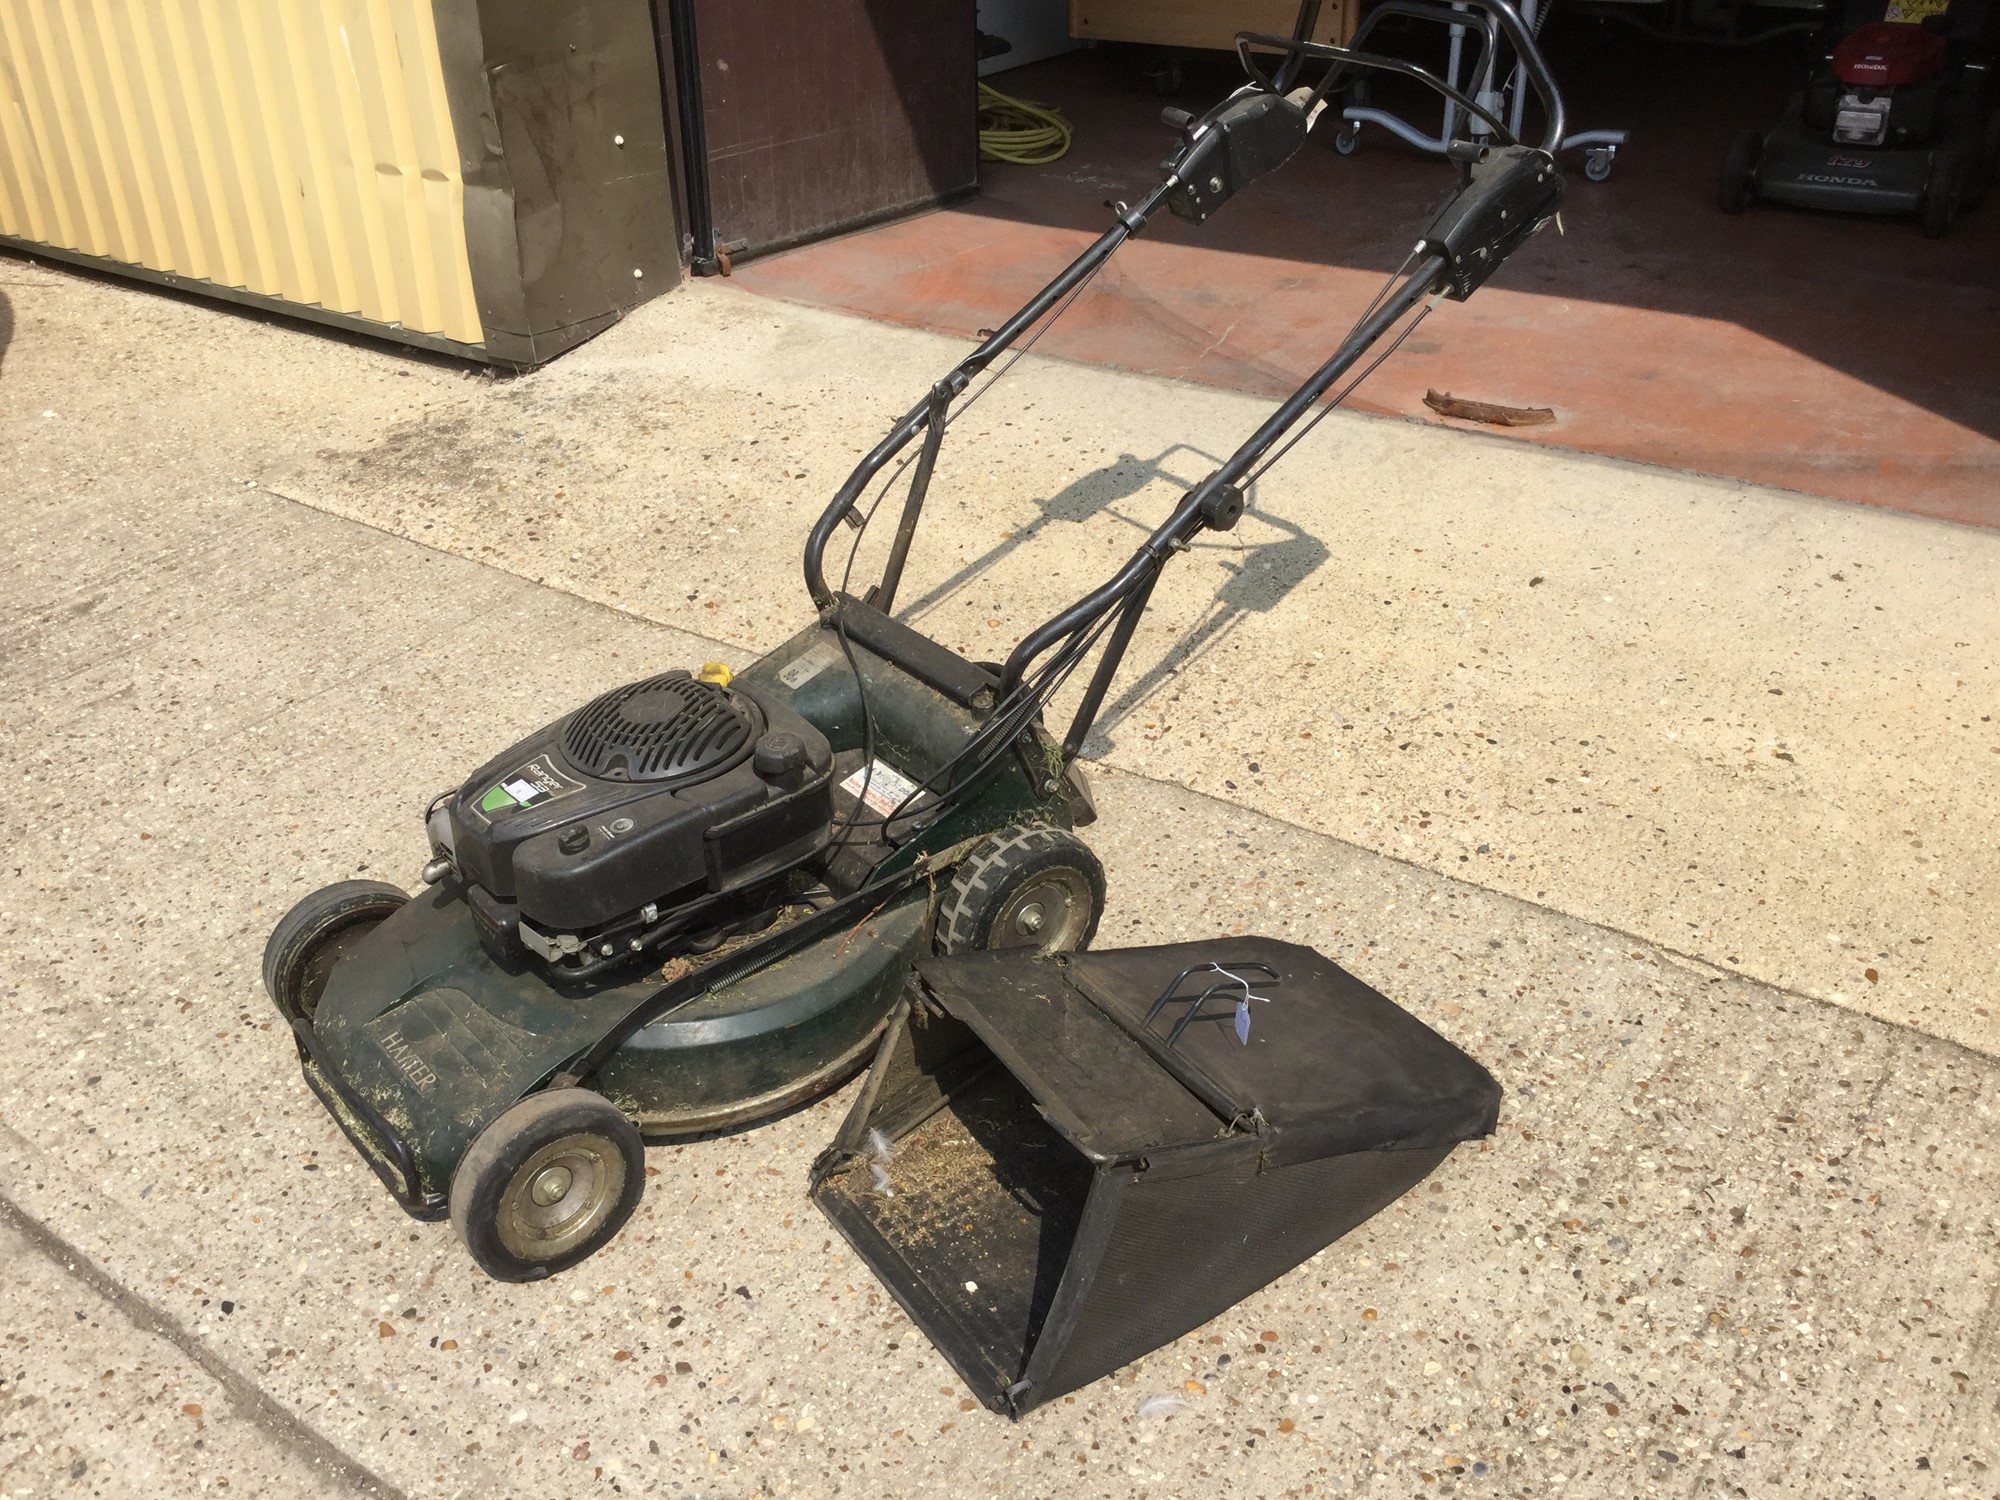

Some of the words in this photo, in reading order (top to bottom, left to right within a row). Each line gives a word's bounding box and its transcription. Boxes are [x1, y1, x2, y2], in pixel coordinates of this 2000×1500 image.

[1797, 173, 1878, 187] HONDA
[527, 763, 564, 790] Ranger
[529, 780, 550, 793] 53
[380, 1031, 437, 1092] HAYTER
